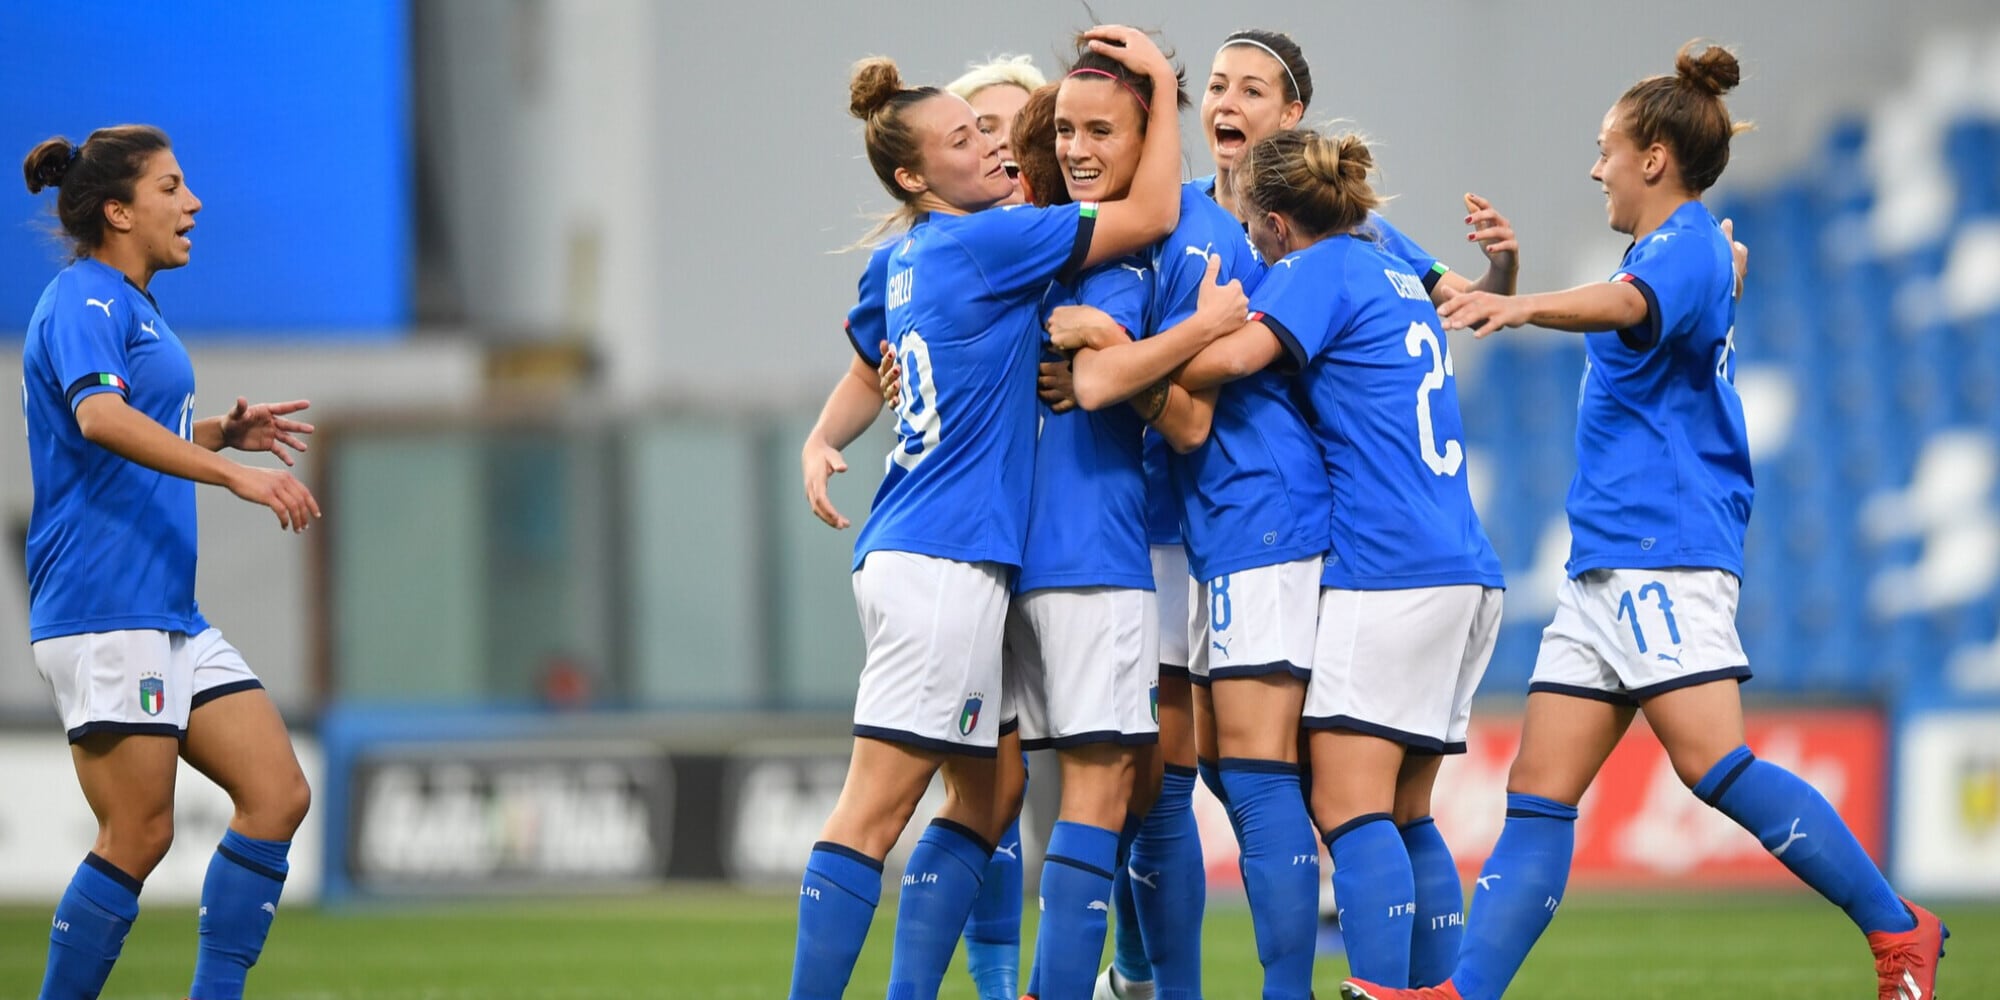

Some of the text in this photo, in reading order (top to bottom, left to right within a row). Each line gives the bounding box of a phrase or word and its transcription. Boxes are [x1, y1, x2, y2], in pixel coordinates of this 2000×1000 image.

[888, 266, 913, 311] GALLI
[1405, 321, 1464, 477] 2
[1210, 573, 1232, 632] 8
[1617, 580, 1682, 655] 17
